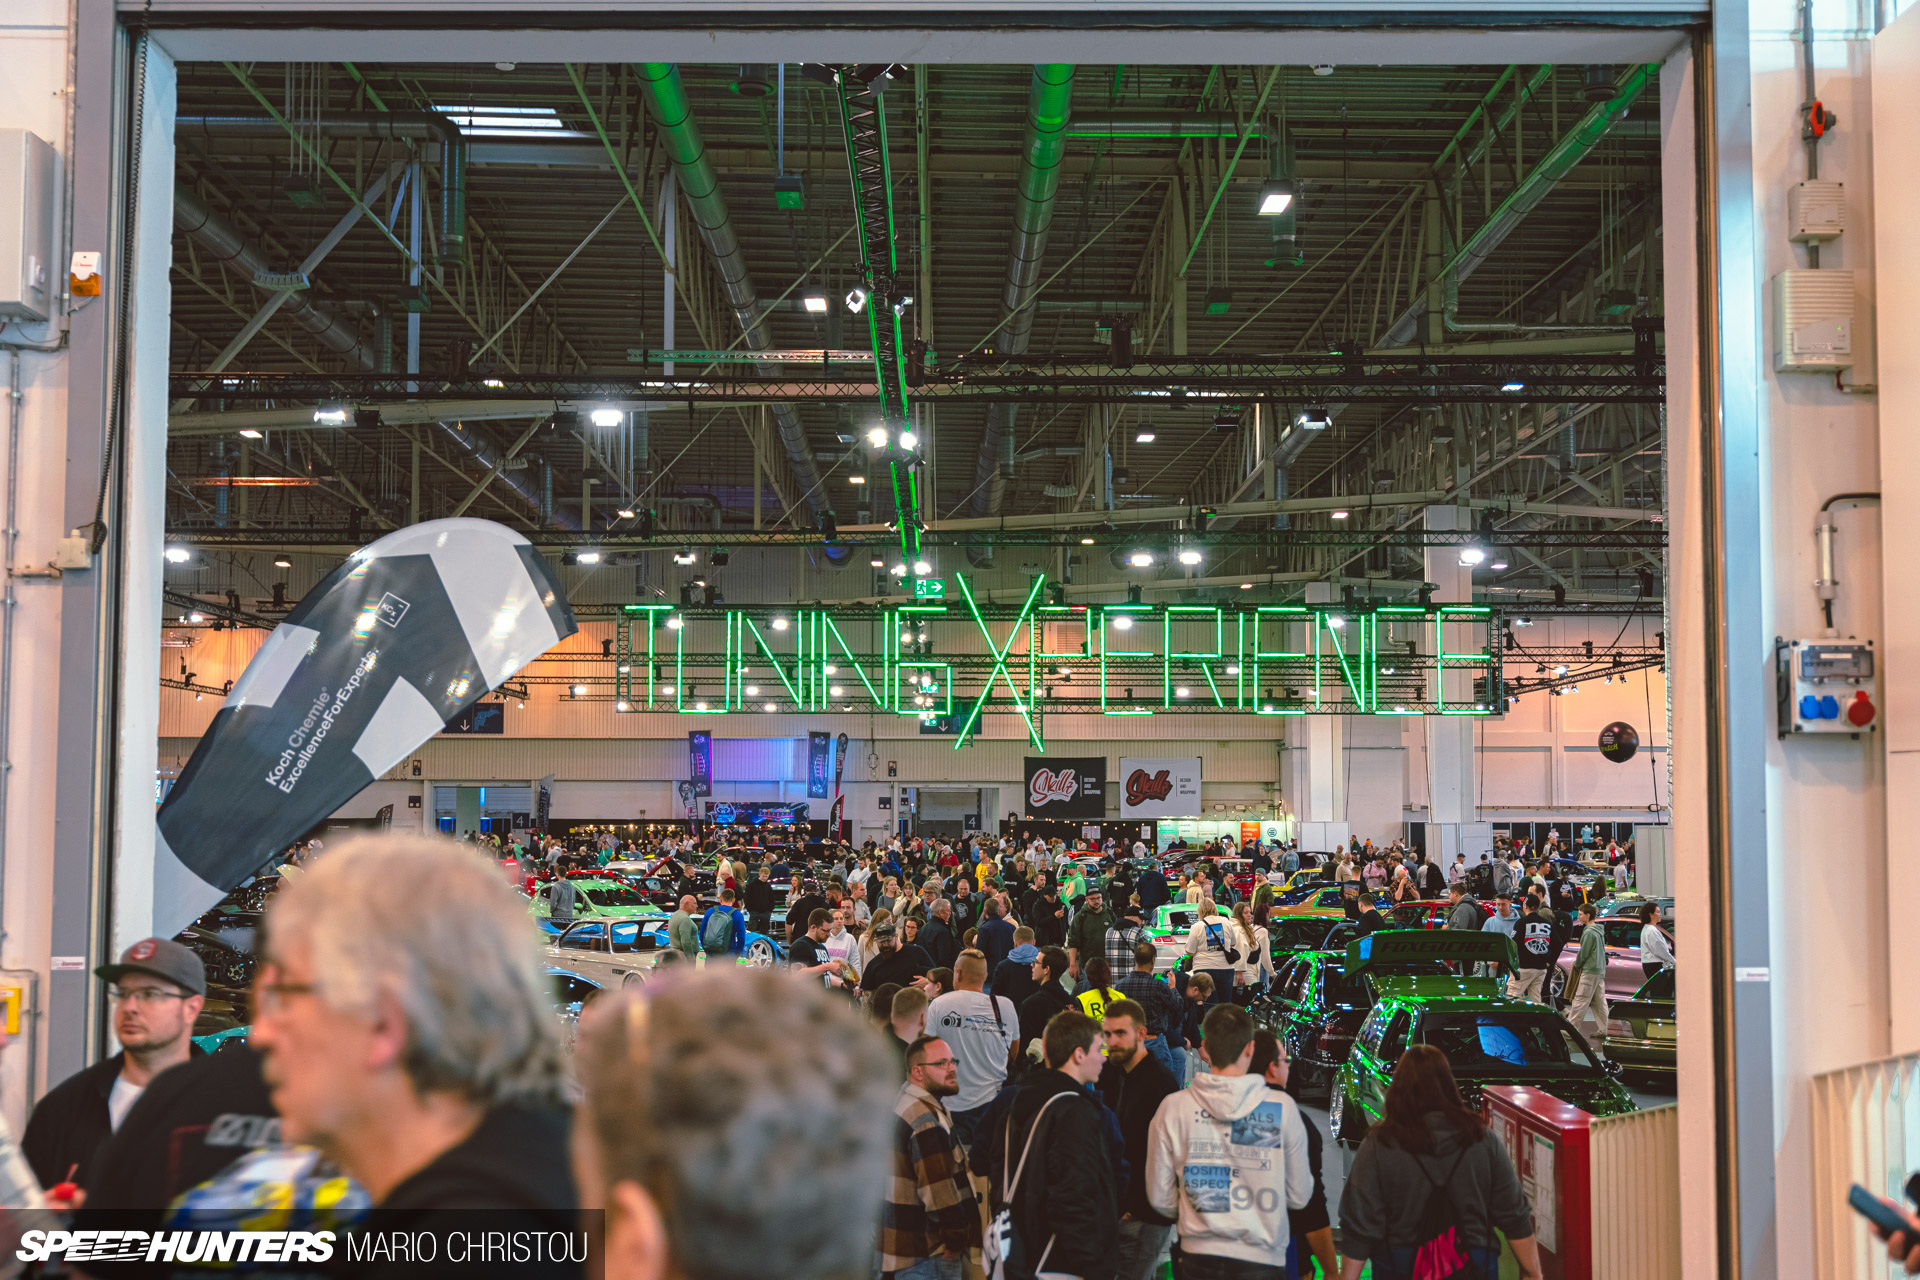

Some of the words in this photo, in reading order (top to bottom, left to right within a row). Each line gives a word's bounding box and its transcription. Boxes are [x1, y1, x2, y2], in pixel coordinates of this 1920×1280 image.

[265, 749, 296, 786] Koch
[516, 815, 525, 828] 4
[968, 816, 977, 829] 4
[1183, 1165, 1240, 1178] POSITIVE
[1184, 1179, 1233, 1190] ASPECT
[1231, 1184, 1279, 1213] 90
